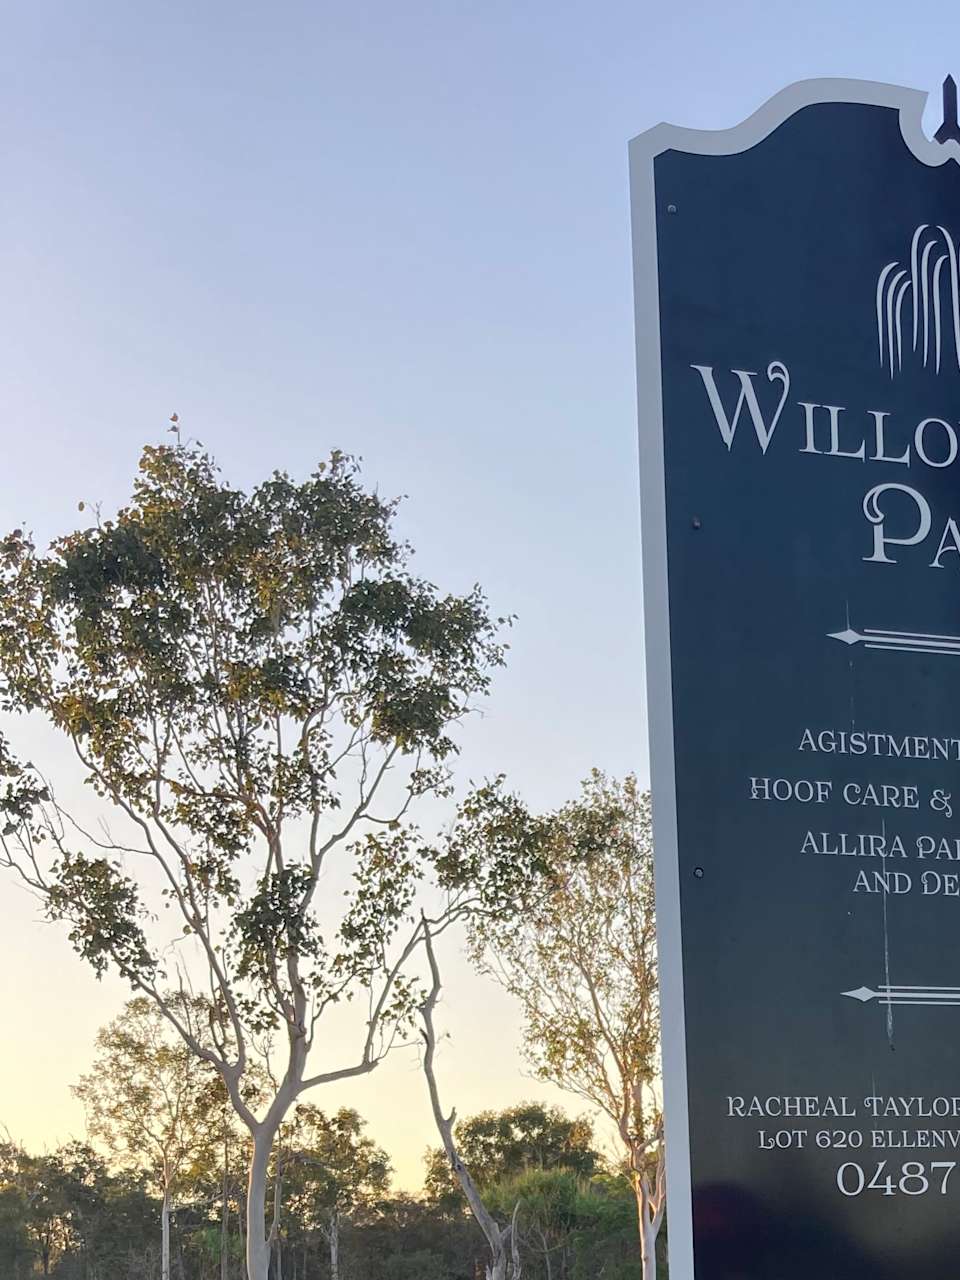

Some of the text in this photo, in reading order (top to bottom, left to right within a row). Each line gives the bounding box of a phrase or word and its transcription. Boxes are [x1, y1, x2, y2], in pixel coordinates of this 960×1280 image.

[750, 777, 833, 803] HOOF
[843, 783, 920, 809] CARE
[929, 789, 953, 818] &
[800, 830, 908, 858] ALLIRA
[852, 870, 912, 894] AND
[727, 1096, 856, 1117] RACHEAL
[758, 1129, 808, 1149] LOT
[815, 1130, 863, 1148] 620
[836, 1160, 956, 1196] 0487
